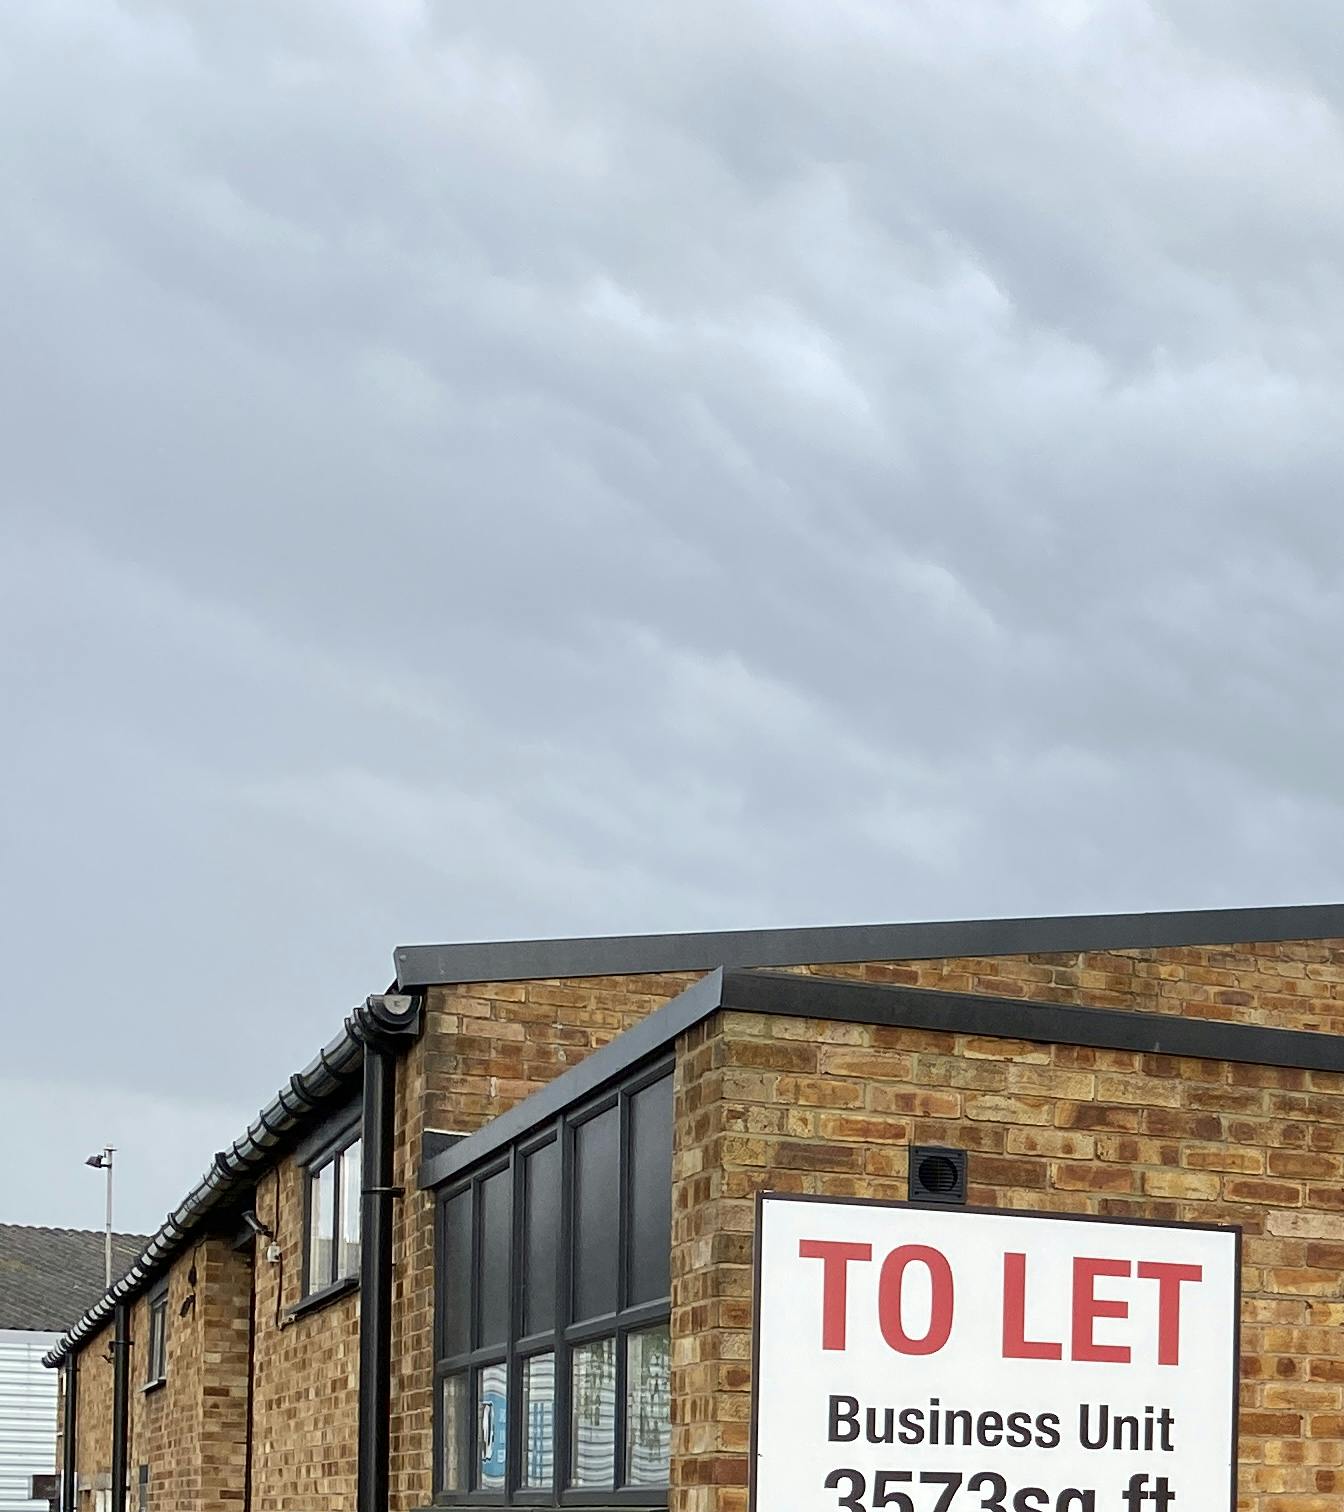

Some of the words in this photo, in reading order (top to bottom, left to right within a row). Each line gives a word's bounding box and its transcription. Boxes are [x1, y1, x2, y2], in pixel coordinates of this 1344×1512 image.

[800, 1240, 953, 1355] TO
[1003, 1253, 1202, 1365] LET
[828, 1395, 1060, 1448] Business
[1080, 1404, 1174, 1451] Unit
